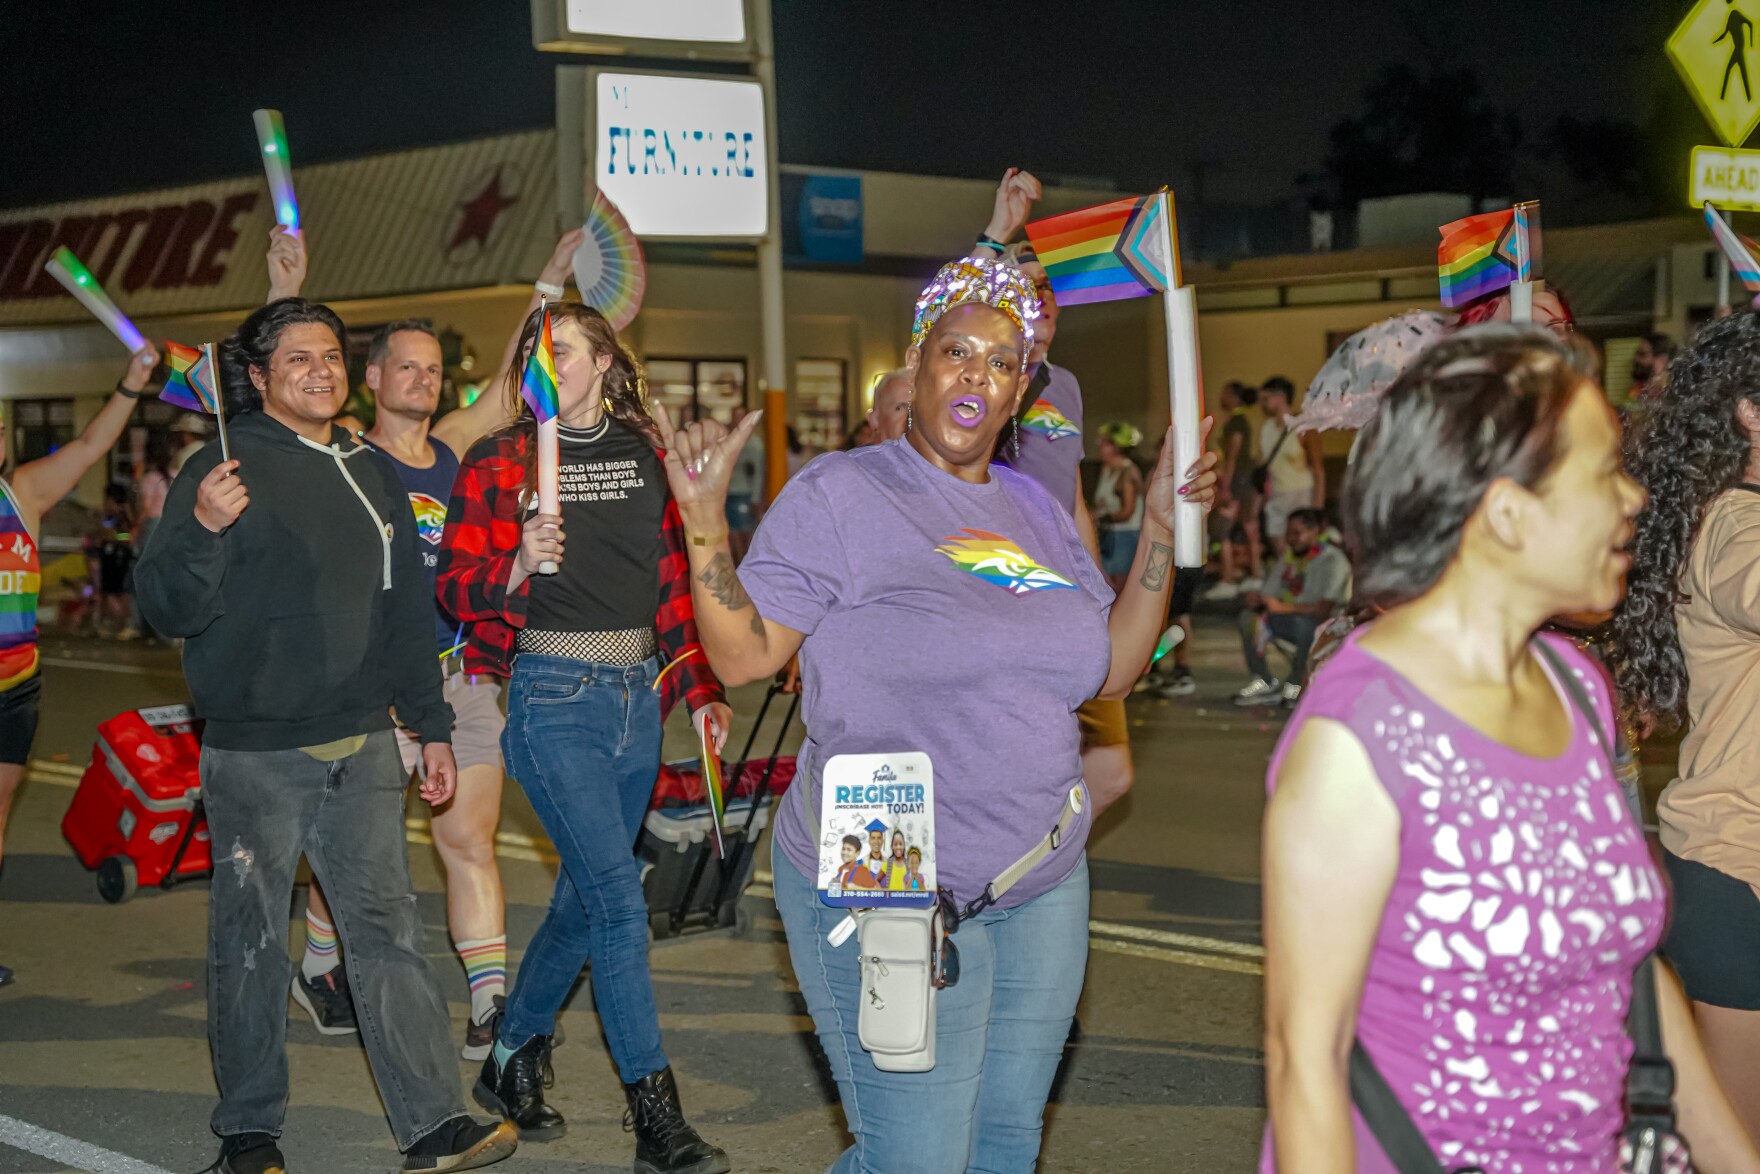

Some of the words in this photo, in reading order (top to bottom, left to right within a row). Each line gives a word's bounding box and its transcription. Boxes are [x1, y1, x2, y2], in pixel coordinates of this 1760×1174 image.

[1704, 166, 1758, 191] AHEAD
[586, 462, 604, 472] HAS
[605, 460, 638, 470] BIGGER
[559, 473, 587, 482] BLEMS
[588, 472, 611, 481] THAN
[612, 470, 636, 480] BOYS
[578, 482, 600, 491] BOYS
[602, 481, 619, 490] AND
[620, 478, 644, 488] GIRLS
[558, 493, 577, 502] WHO
[579, 492, 598, 501] KISS
[600, 491, 628, 500] GIRLS.
[835, 784, 925, 803] REGISTER
[887, 803, 925, 814] TODAY!
